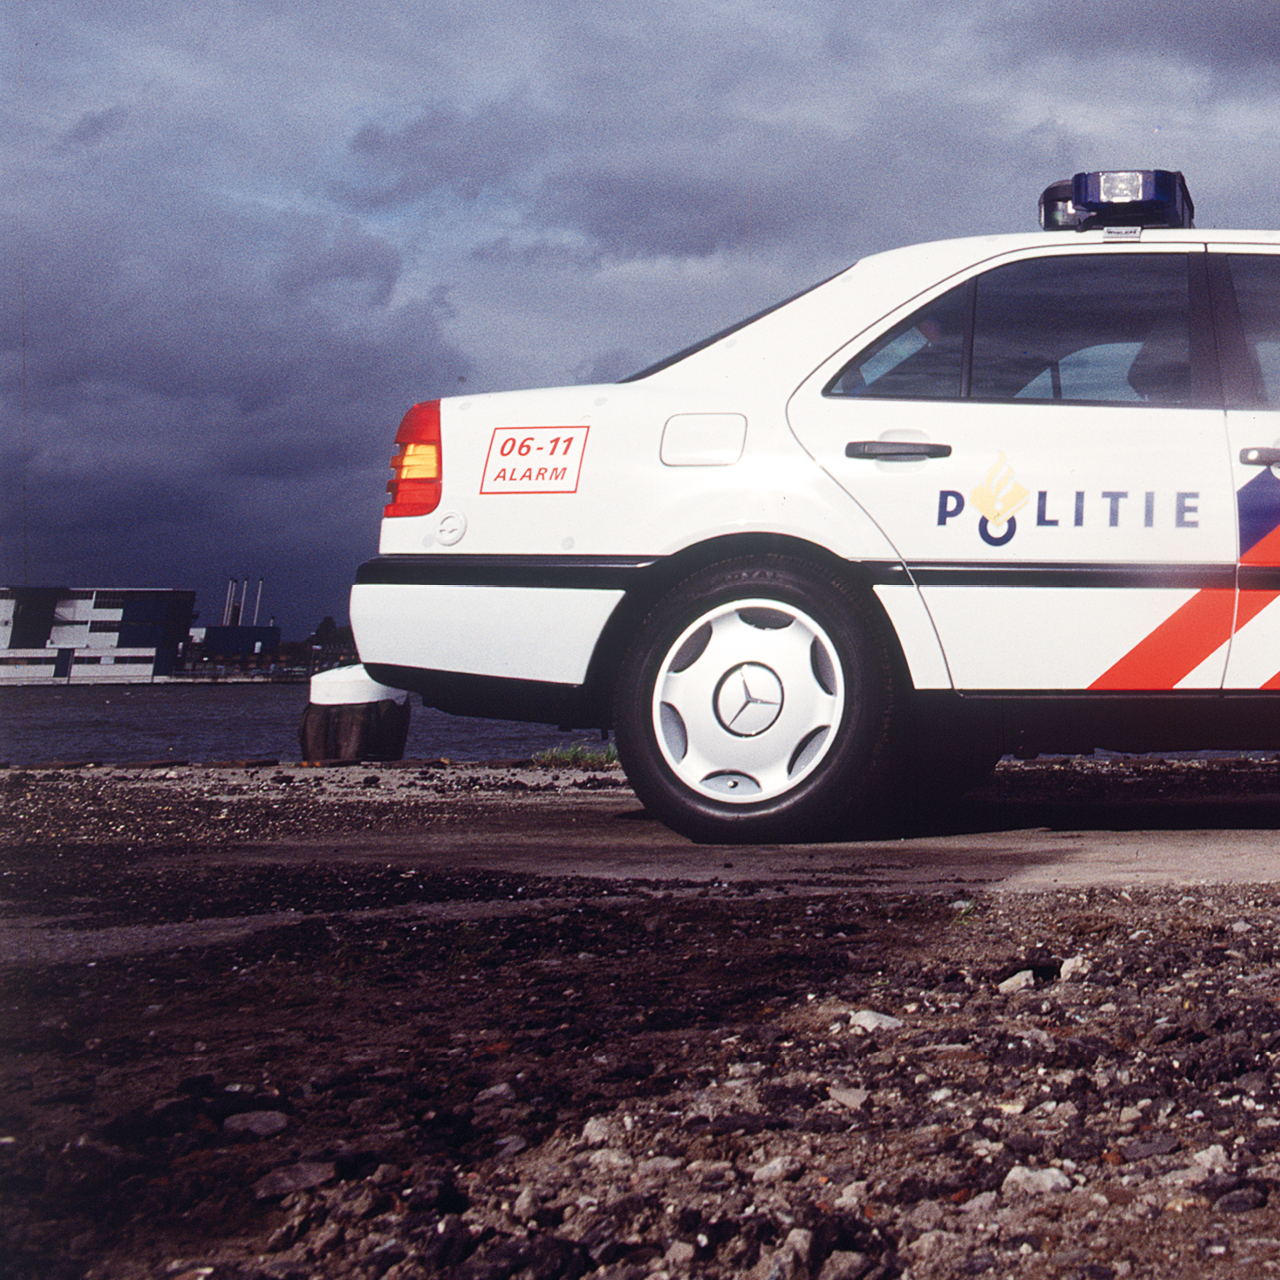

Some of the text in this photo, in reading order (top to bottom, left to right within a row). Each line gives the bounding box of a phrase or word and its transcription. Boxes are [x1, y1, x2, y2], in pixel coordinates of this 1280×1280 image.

[500, 437, 574, 456] 06-11
[494, 467, 567, 481] ALARM
[937, 490, 1199, 546] POLITIE
